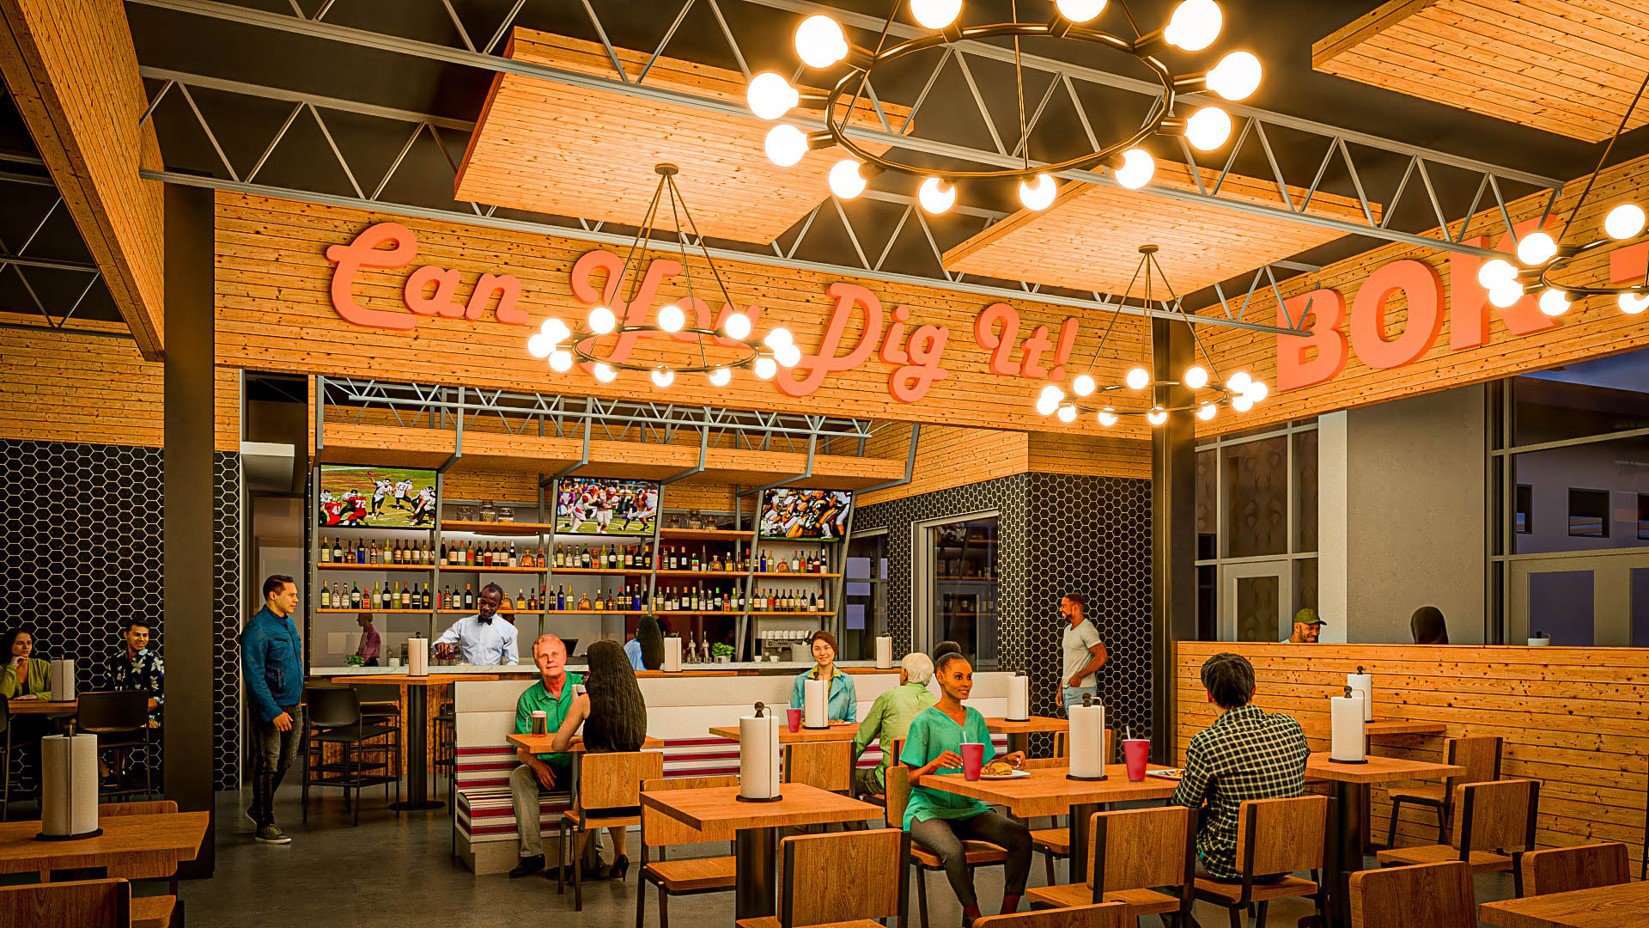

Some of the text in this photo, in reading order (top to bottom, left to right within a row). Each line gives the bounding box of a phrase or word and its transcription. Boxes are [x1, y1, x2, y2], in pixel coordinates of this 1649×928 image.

[326, 222, 1079, 402] Can You Dig It!
